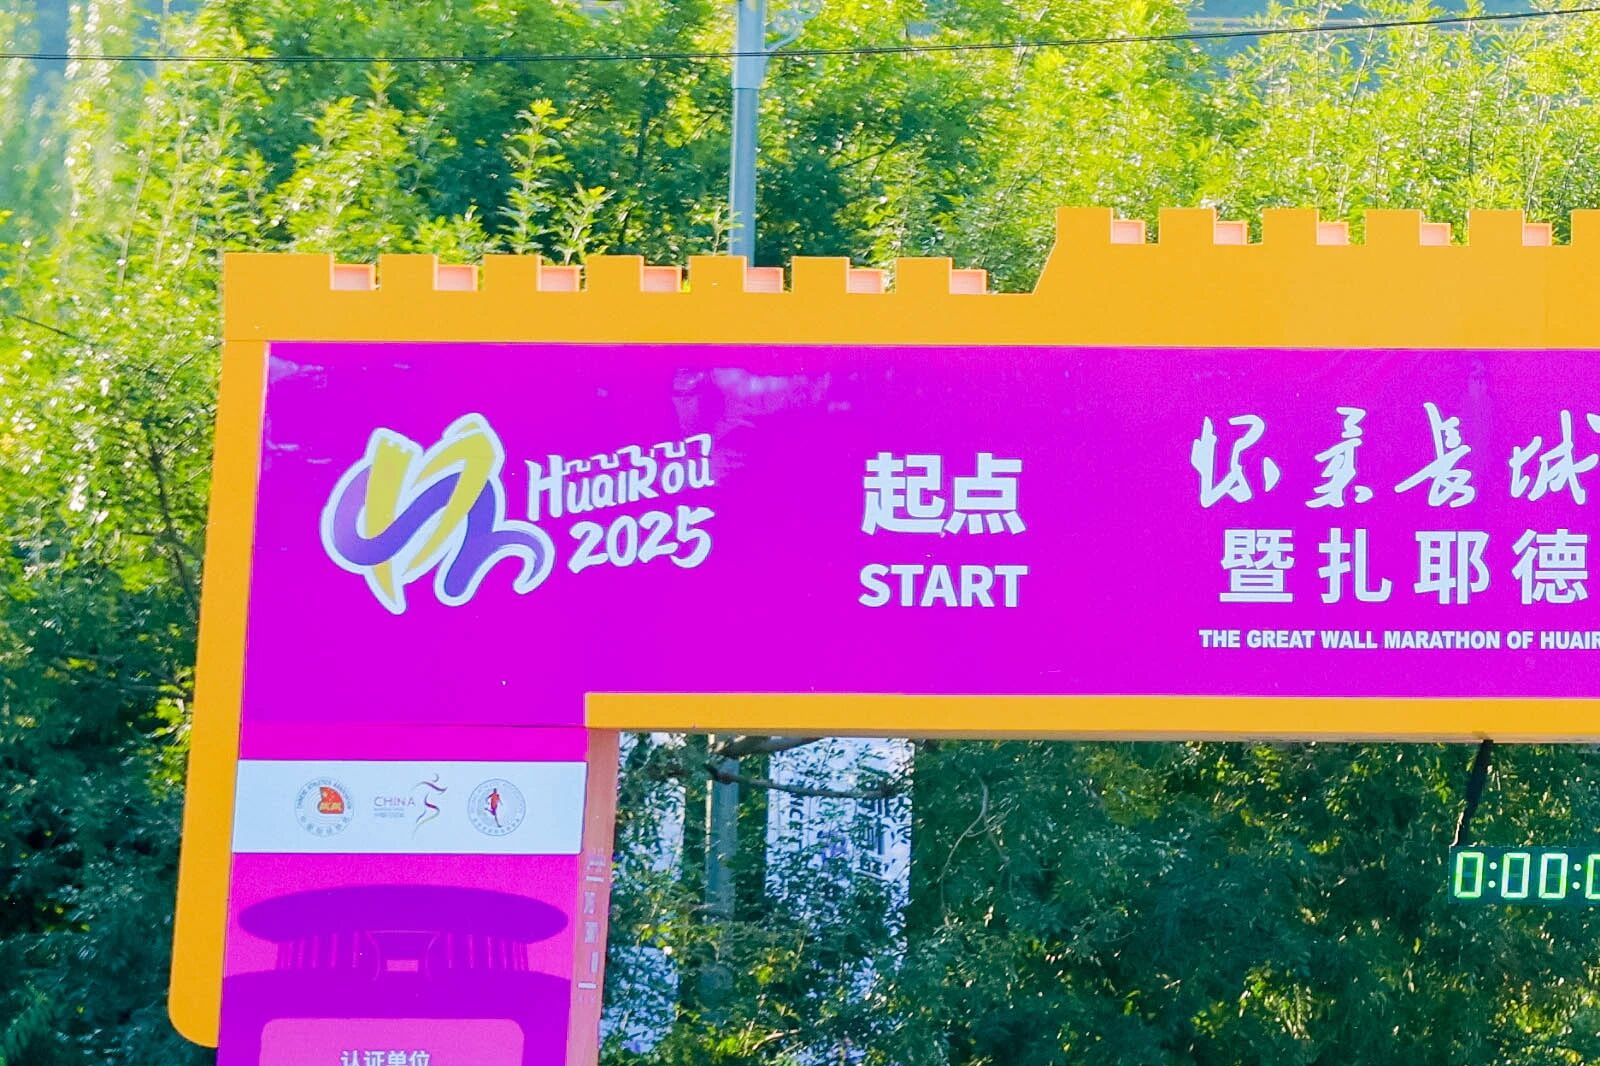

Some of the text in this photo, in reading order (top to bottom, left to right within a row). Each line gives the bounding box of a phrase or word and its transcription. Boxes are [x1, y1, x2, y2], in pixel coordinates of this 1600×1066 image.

[863, 453, 1025, 535] 起点
[568, 507, 715, 573] 2025
[858, 563, 1028, 608] START
[1200, 630, 1239, 650] THE
[1246, 630, 1314, 650] GREAT
[1321, 630, 1378, 650] WALL
[1384, 630, 1501, 650] MARATHON
[1507, 630, 1533, 650] OF
